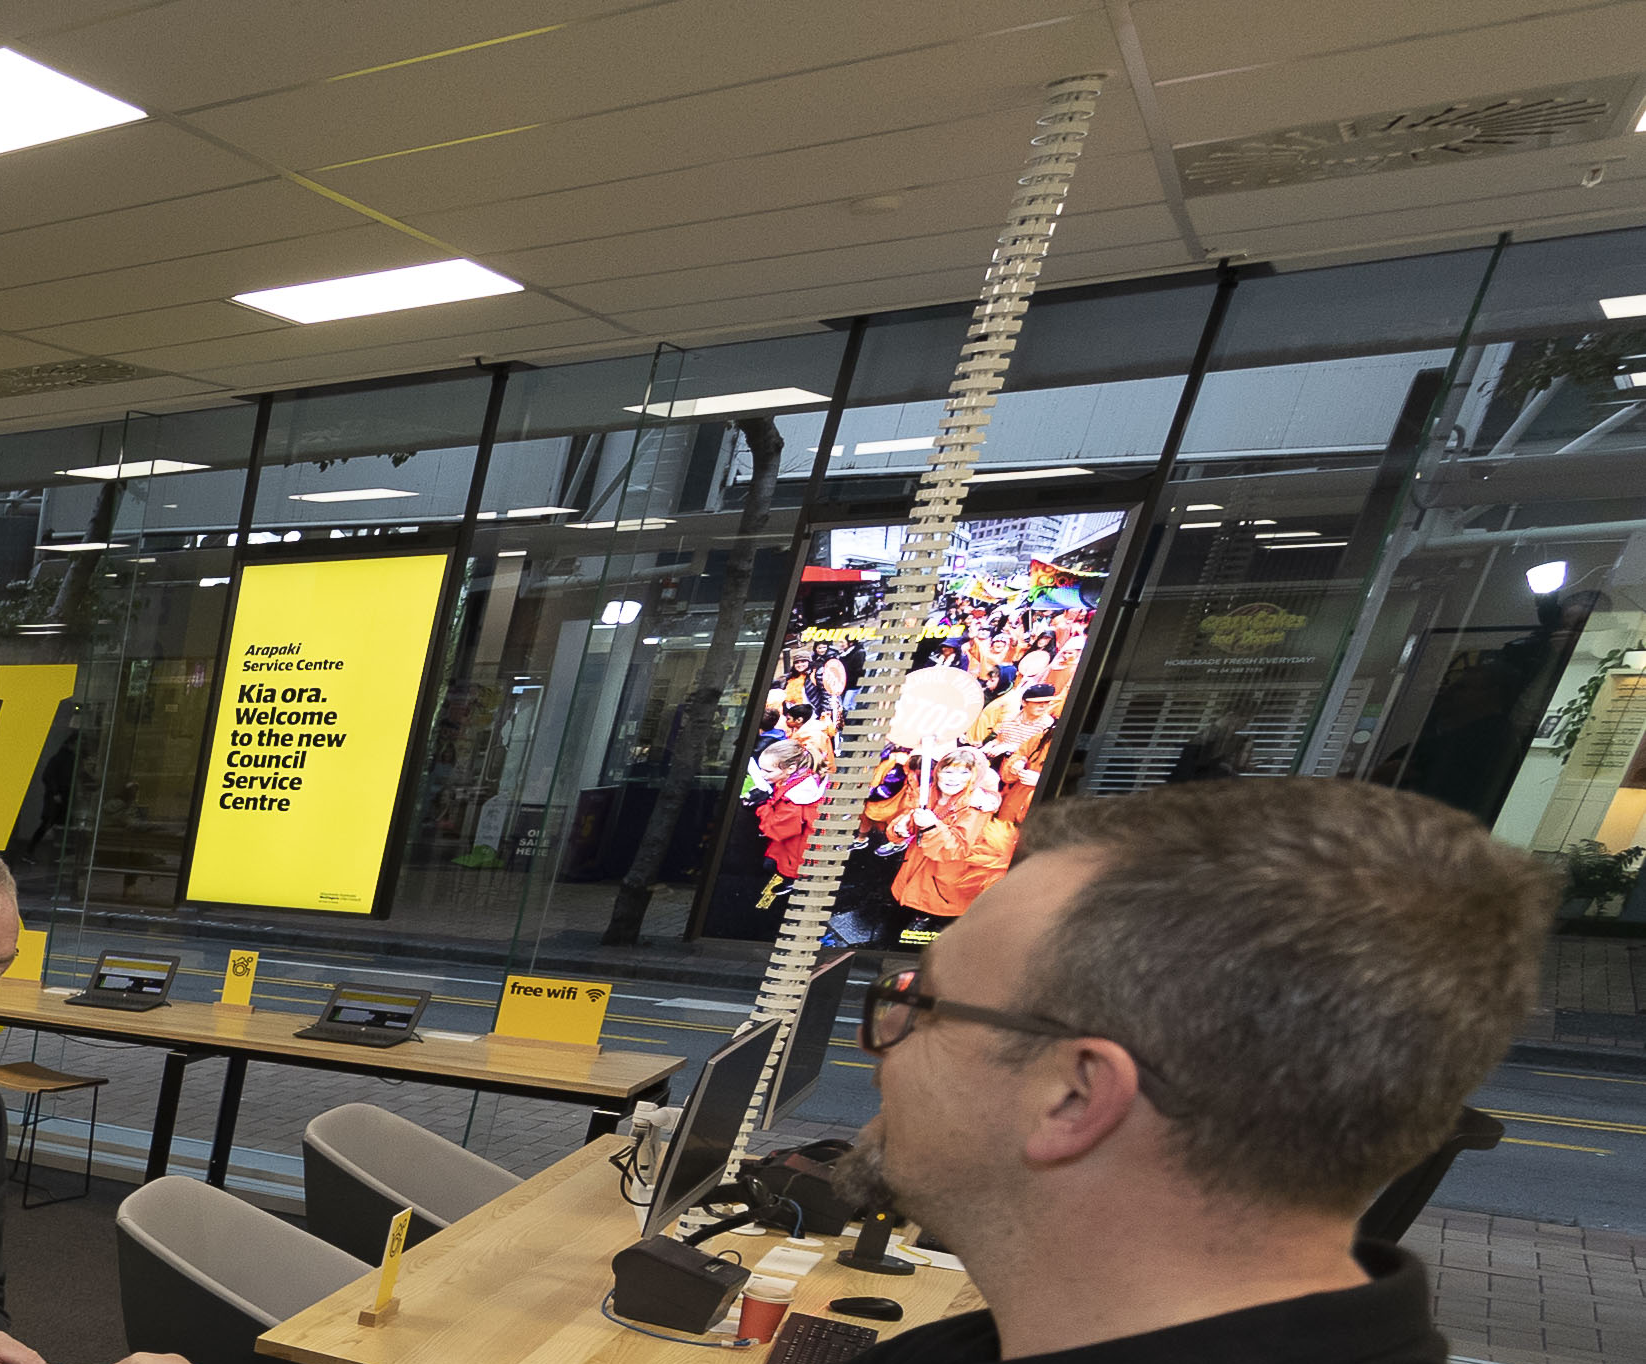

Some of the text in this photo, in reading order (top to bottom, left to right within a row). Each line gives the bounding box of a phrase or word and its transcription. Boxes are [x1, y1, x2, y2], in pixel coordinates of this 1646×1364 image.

[245, 643, 302, 658] Arapaki
[243, 659, 344, 672] Service Centre
[1164, 658, 1220, 667] HOMEMADE
[1223, 657, 1257, 666] FRESH
[238, 683, 327, 704] Kia ora.
[235, 707, 338, 725] Welcome
[230, 729, 347, 747] to the new
[227, 750, 307, 769] Council
[222, 771, 302, 790] Service
[219, 793, 291, 812] Centre
[510, 982, 578, 1000] free wifi
